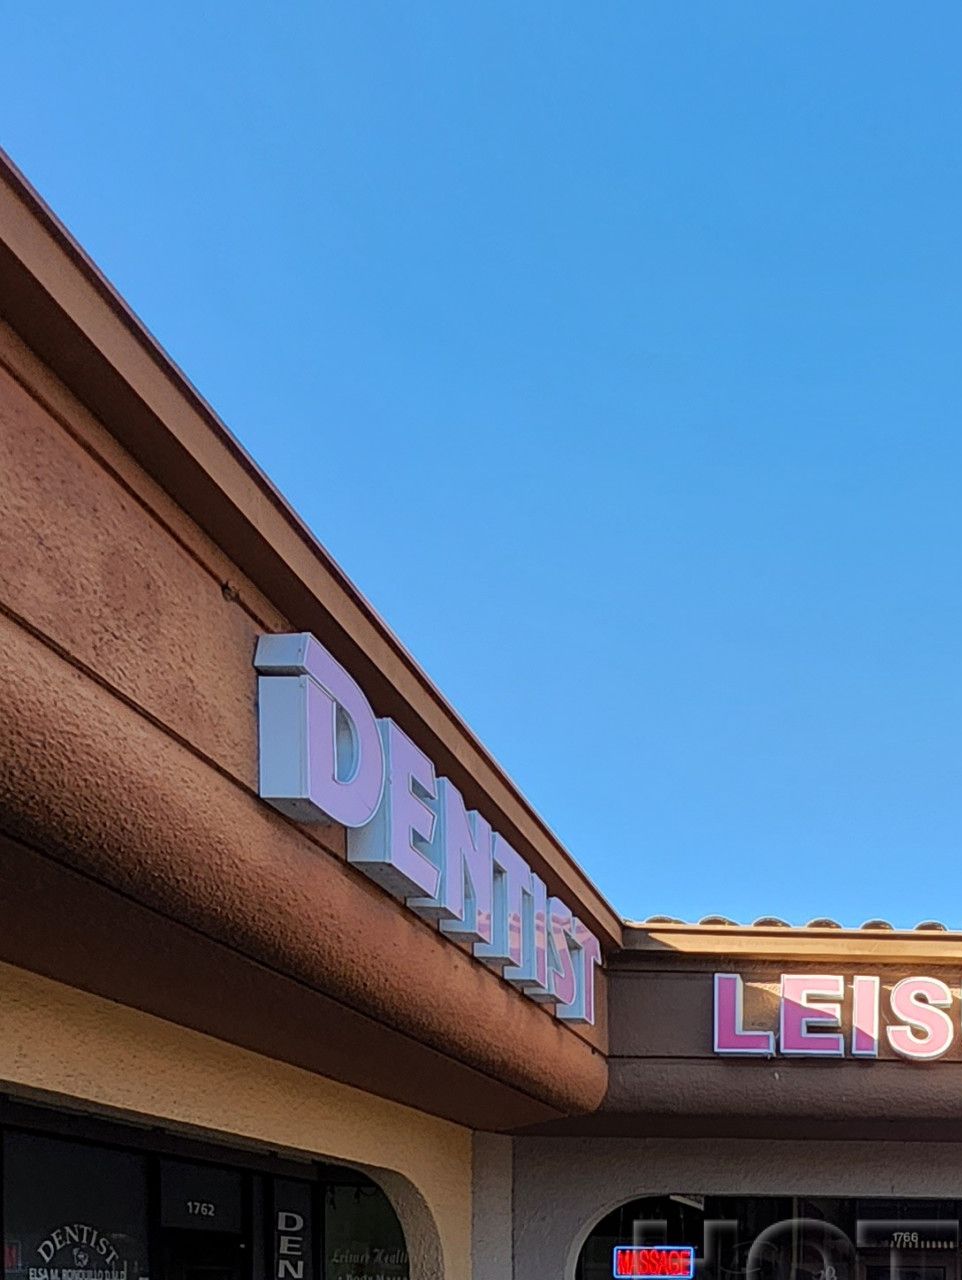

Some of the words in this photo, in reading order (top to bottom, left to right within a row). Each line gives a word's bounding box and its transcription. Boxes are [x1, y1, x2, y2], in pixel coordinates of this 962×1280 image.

[254, 632, 602, 1026] DENTIST
[187, 1201, 215, 1217] 1762
[37, 1224, 120, 1265] DENTIST
[892, 1231, 919, 1244] 1766
[616, 1248, 691, 1277] MASSAGE
[29, 1268, 49, 1280] ELSA
